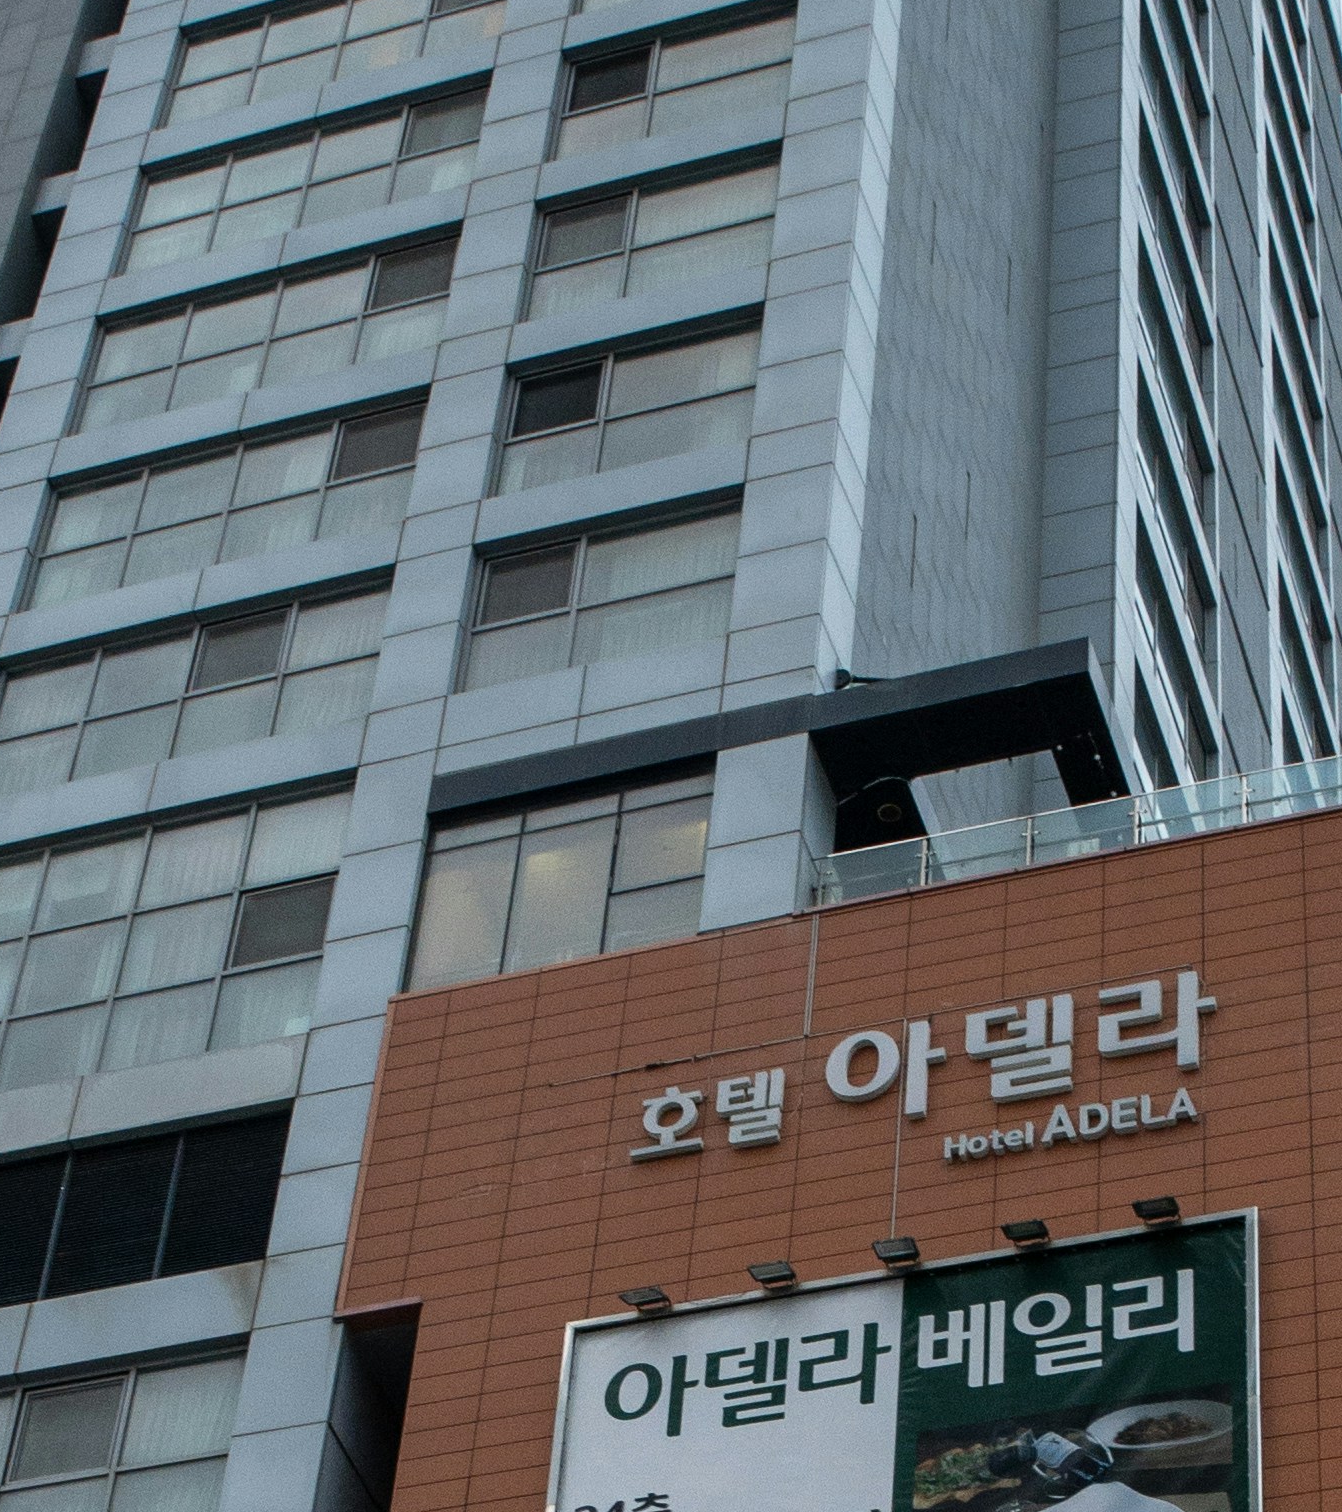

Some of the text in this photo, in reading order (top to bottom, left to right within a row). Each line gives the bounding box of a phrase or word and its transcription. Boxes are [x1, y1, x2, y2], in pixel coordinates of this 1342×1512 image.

[629, 970, 1218, 1163] 호텔 아델라
[943, 1088, 1198, 1163] Hotel ADELA
[605, 1269, 1195, 1437] 아델라 베일리
